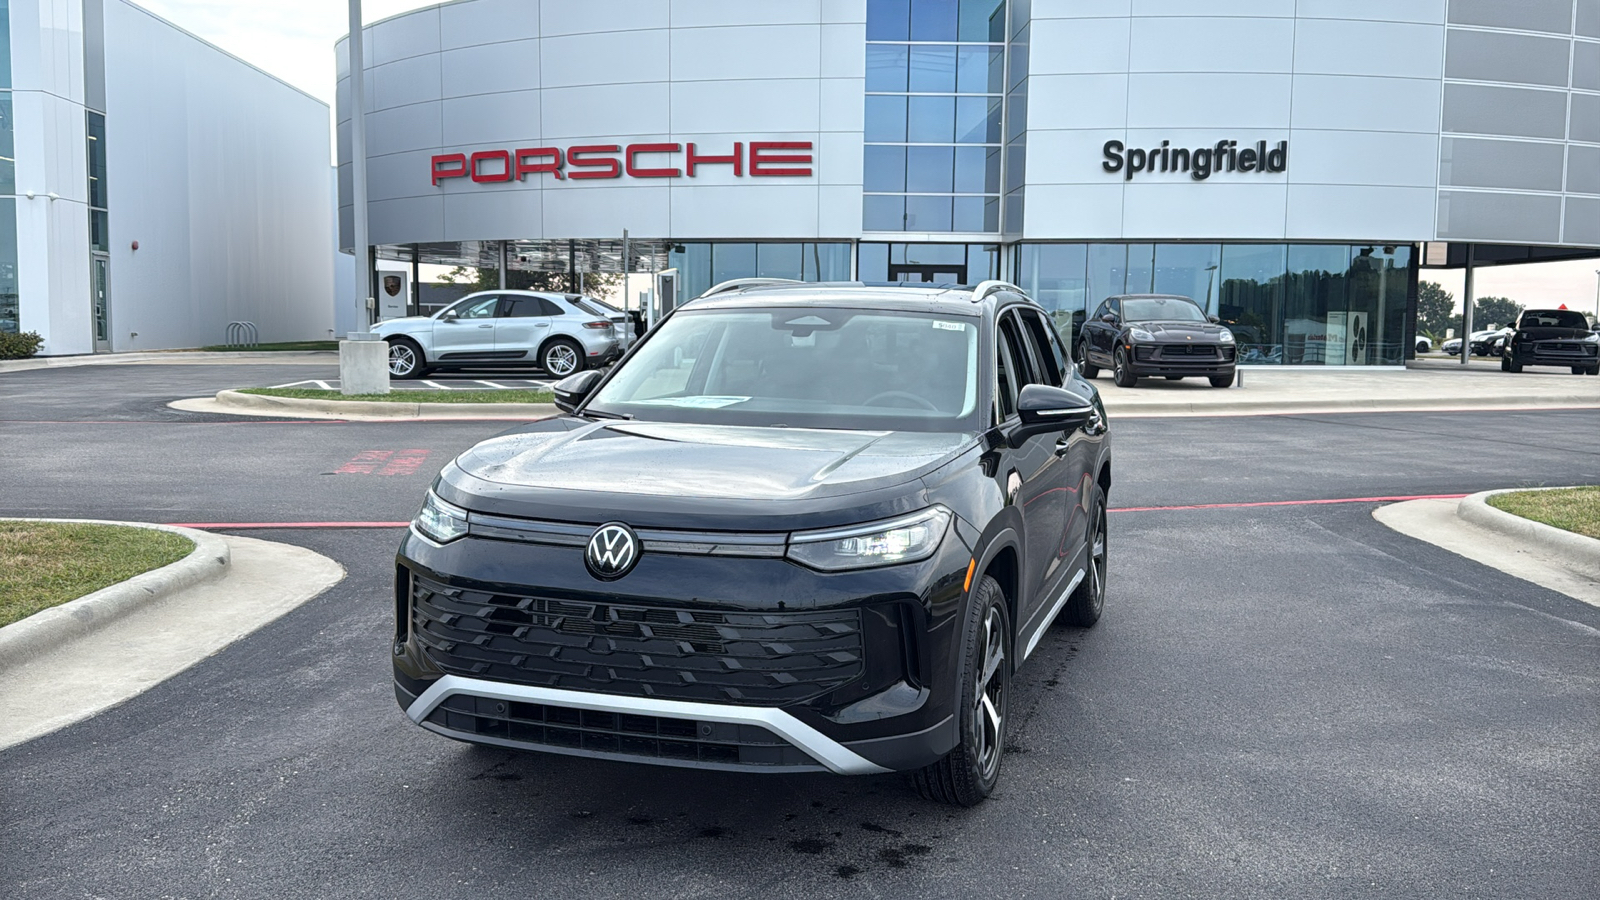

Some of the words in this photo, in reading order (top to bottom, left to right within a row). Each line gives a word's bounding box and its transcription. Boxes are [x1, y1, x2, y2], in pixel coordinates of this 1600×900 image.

[431, 142, 813, 186] PORSCHE
[1102, 140, 1288, 181] Springfield
[588, 526, 633, 570] VW
